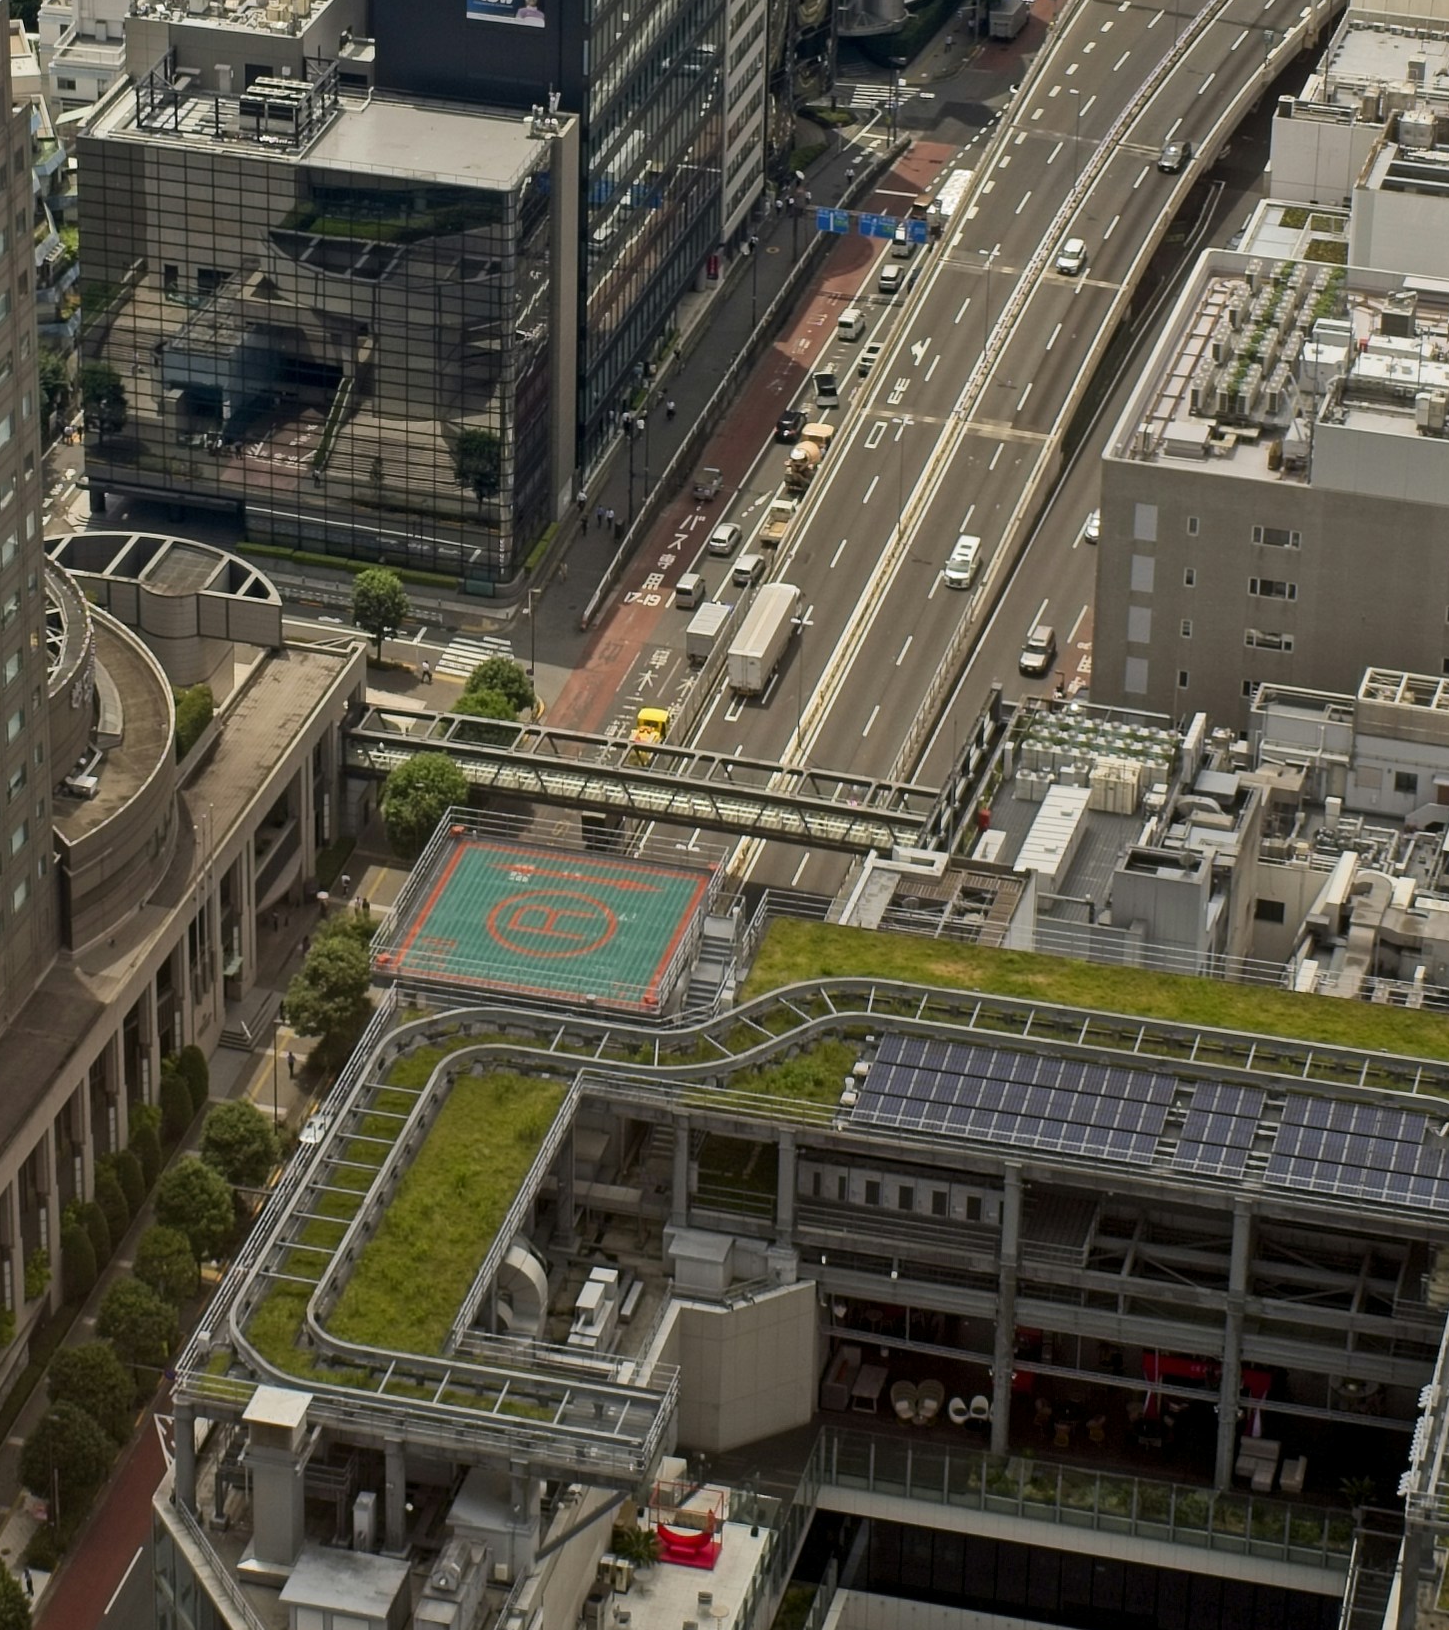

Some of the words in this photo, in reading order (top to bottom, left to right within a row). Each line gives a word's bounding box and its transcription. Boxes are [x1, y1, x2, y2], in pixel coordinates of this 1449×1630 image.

[641, 514, 706, 591] バス専用
[623, 591, 662, 607] 17-19
[507, 903, 596, 940] R
